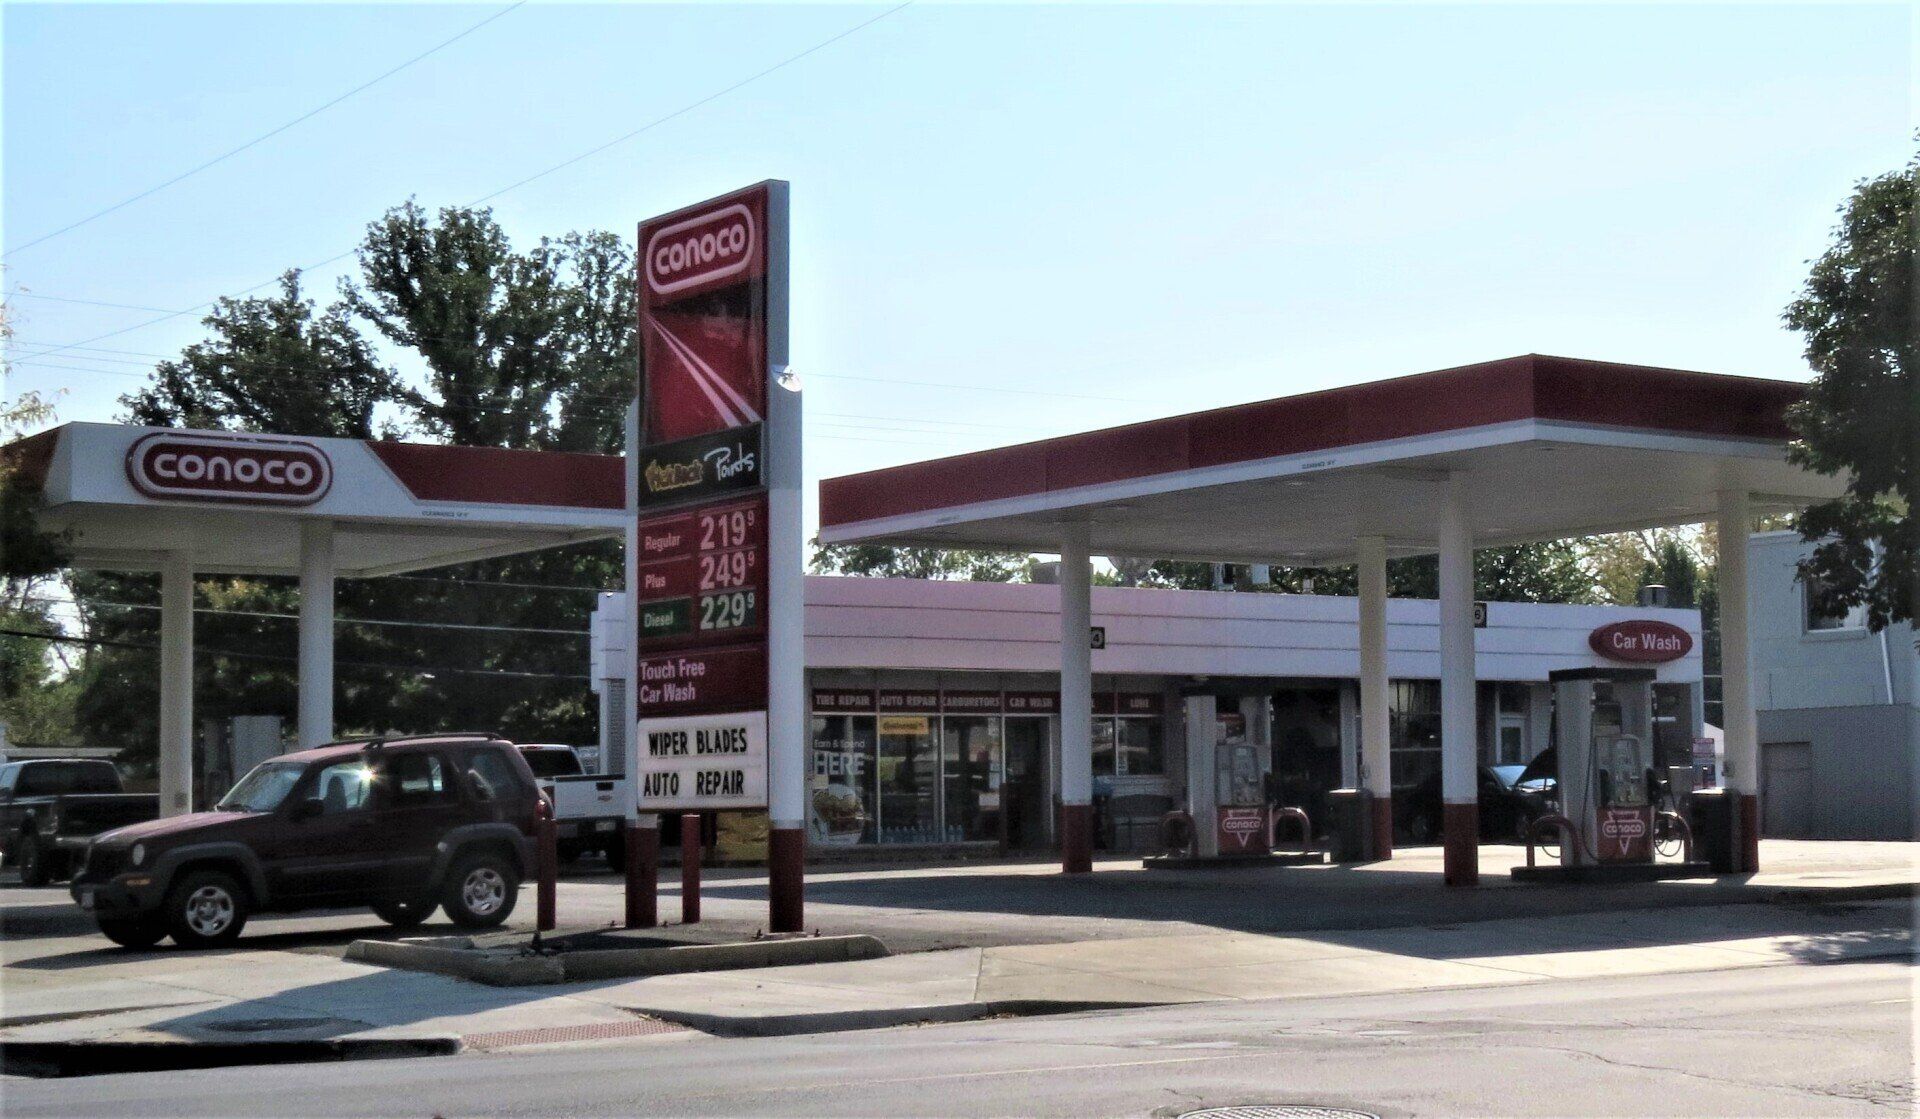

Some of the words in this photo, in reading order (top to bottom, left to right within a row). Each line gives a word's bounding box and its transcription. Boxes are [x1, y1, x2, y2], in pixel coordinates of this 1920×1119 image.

[703, 442, 755, 481] Points
[644, 532, 681, 552] Regular
[645, 574, 666, 589] Plus
[644, 611, 674, 628] Diesel
[1613, 632, 1637, 649] Car
[1641, 633, 1681, 650] Wash
[640, 660, 676, 680] Touch
[679, 659, 706, 677] Free
[640, 685, 661, 703] Car
[664, 682, 696, 702] Wash
[839, 695, 871, 705] REPAIR
[880, 695, 903, 706] AUTO
[906, 695, 937, 706] REPAIR
[1009, 697, 1025, 708] CAR
[648, 731, 689, 756] WIPER
[696, 727, 748, 754] BLADES
[813, 752, 865, 775] HERE
[643, 772, 680, 797] AUTO
[696, 769, 744, 796] REPAIR
